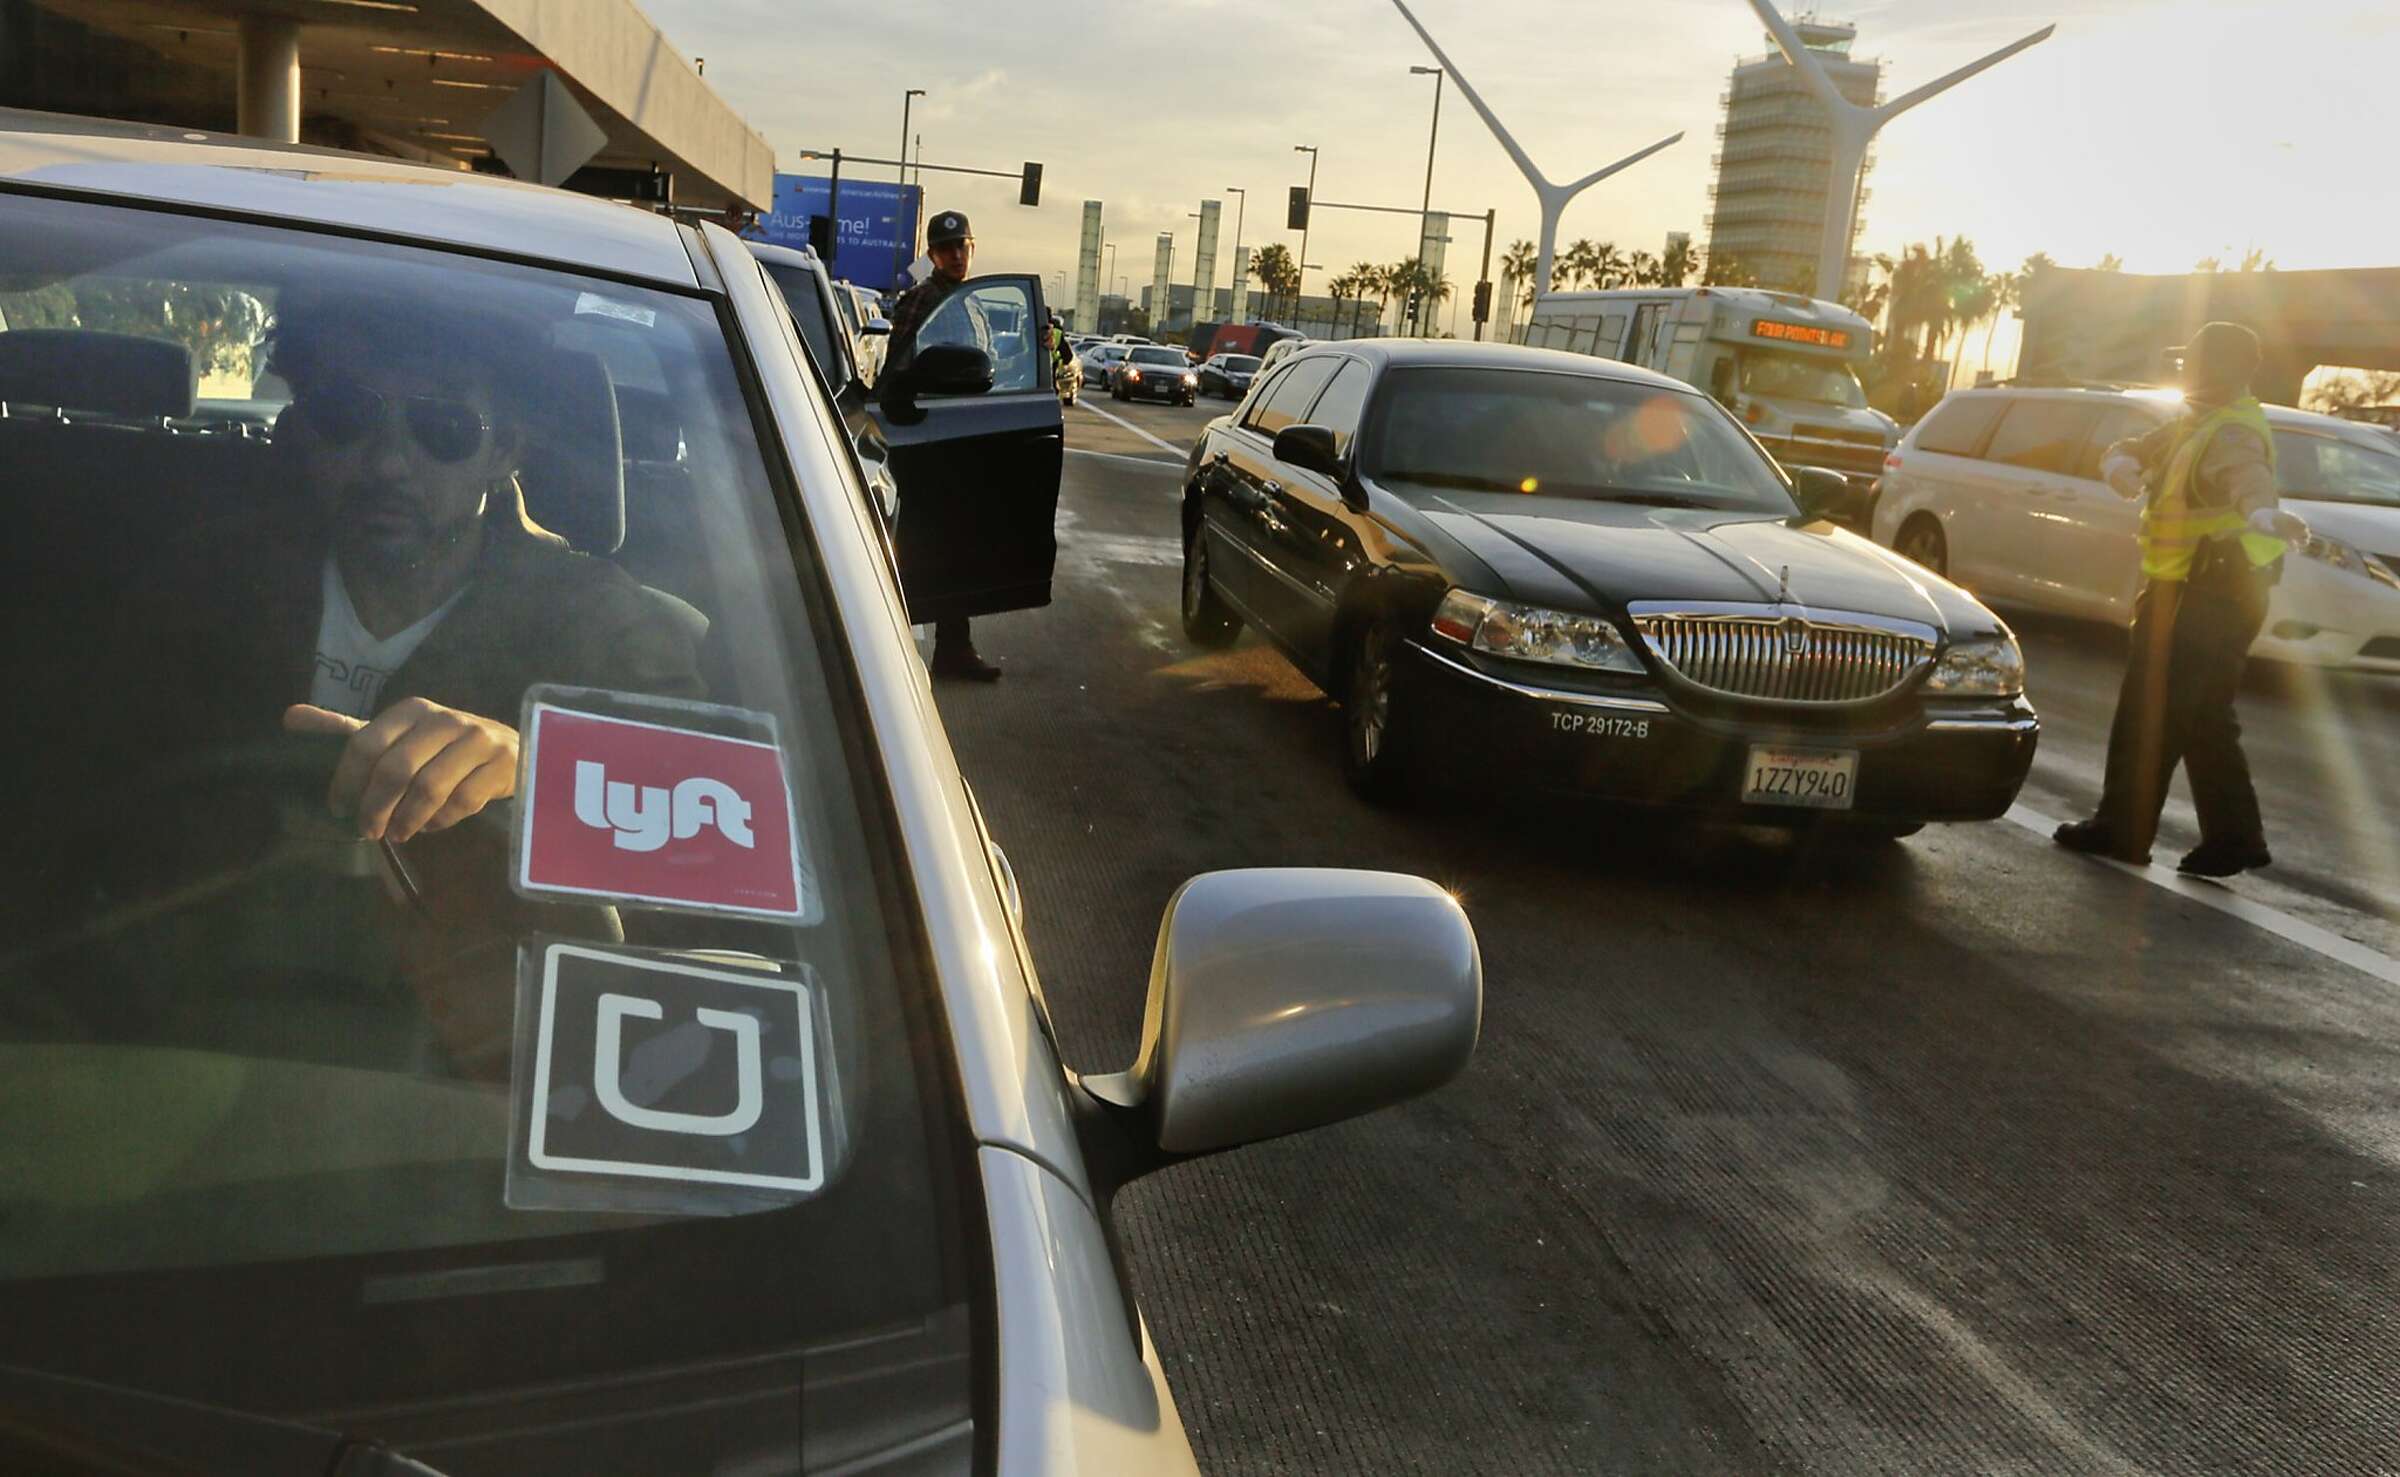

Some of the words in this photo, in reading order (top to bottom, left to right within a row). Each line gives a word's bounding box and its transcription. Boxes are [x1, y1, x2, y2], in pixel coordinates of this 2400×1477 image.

[861, 239, 907, 249] AUSTRAA
[1551, 712, 1584, 731] TCP
[1751, 767, 1847, 797] 1ZZY940
[574, 760, 755, 852] lyft
